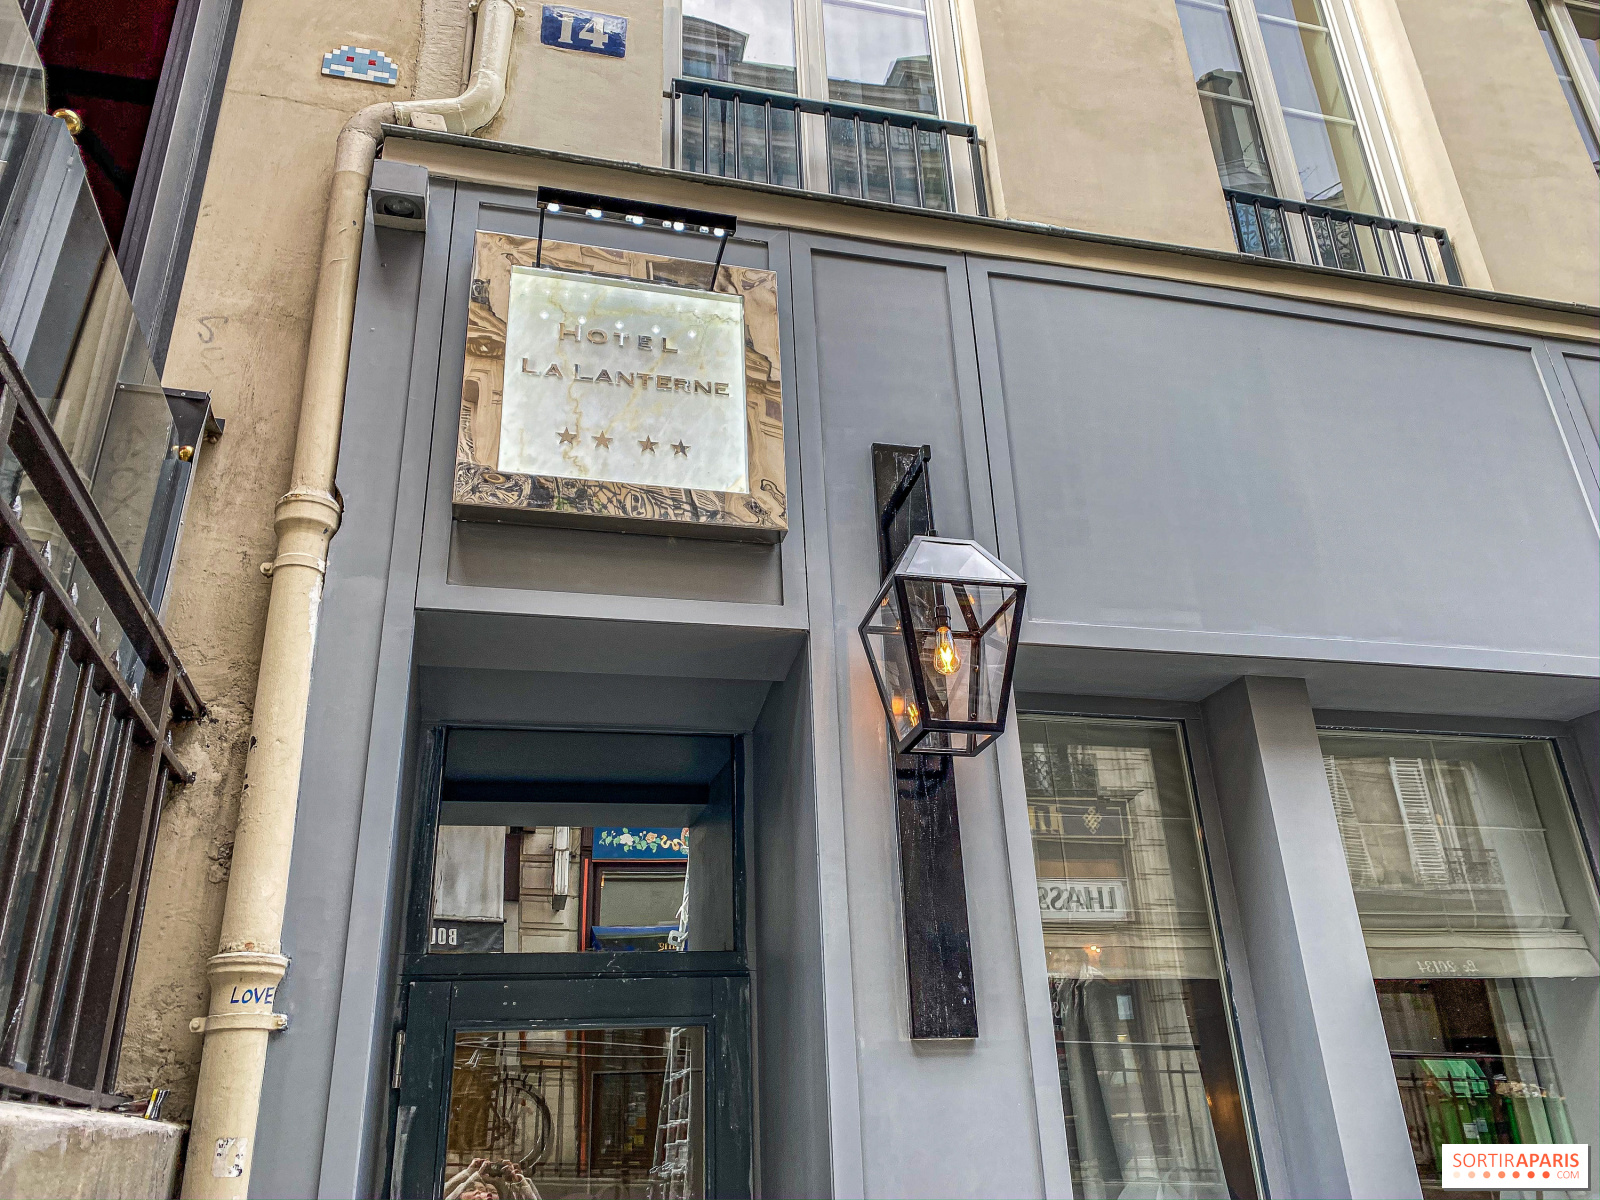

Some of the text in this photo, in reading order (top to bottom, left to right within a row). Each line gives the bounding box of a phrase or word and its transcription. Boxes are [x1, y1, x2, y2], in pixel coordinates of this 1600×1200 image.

[552, 10, 609, 49] 14
[558, 322, 679, 354] HOTEL
[520, 357, 731, 398] LA LANTERNE
[230, 985, 275, 1004] LOVE
